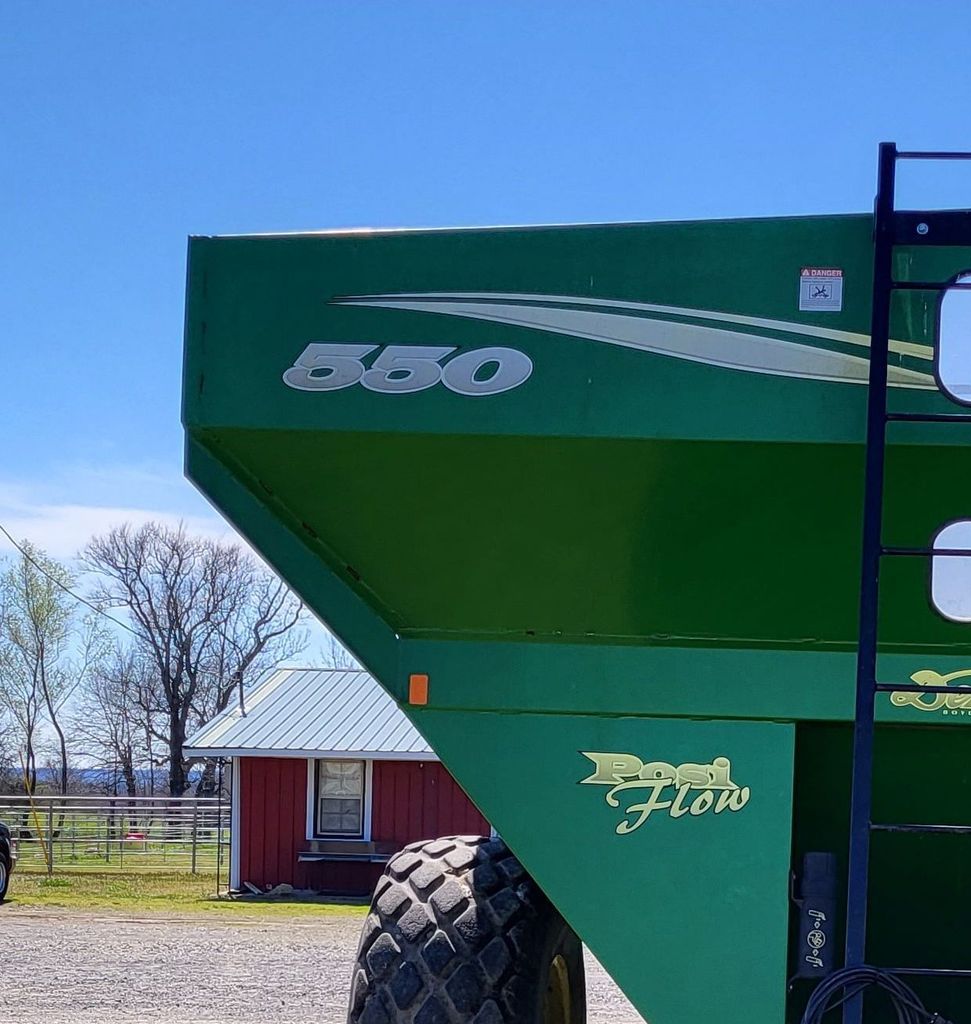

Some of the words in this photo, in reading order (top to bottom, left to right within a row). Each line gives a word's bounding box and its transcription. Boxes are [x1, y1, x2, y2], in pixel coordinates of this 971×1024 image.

[811, 269, 842, 277] DANGER
[282, 342, 534, 396] 550
[576, 751, 741, 790] Posi
[605, 777, 750, 835] Flow
